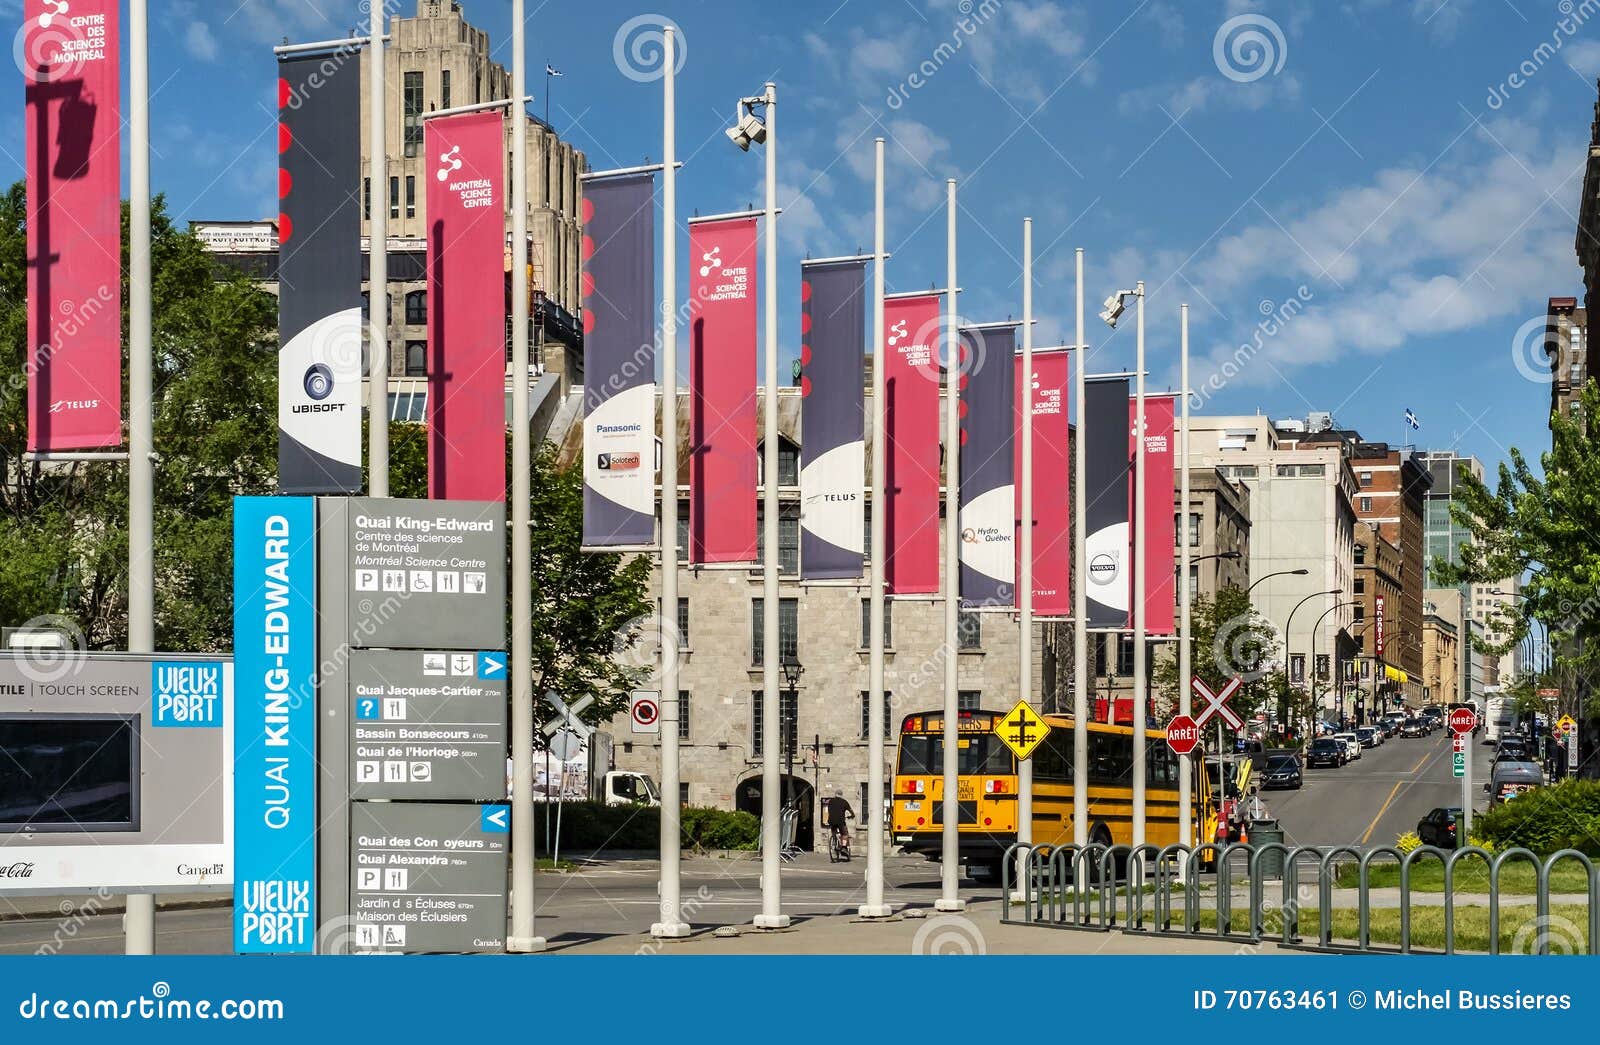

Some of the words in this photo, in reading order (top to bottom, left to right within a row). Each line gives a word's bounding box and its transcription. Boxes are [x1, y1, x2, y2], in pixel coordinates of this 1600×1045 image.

[70, 14, 105, 27] CENTRE
[88, 26, 105, 37] DES
[62, 38, 105, 51] SCIENCES
[460, 188, 492, 200] SCIENCE
[464, 198, 492, 208] CENTRE
[721, 267, 747, 276] CENTRE
[716, 283, 748, 292] SCIENCES
[67, 400, 98, 409] TELUS
[292, 403, 346, 414] UBISOFT
[596, 424, 641, 432] Panasonic
[612, 456, 639, 464] Solotech
[824, 494, 856, 502] TELUS
[356, 516, 391, 529] Quai
[396, 516, 494, 532] King-Edward
[355, 530, 392, 542] Centre
[394, 531, 414, 542] des
[416, 534, 463, 543] sciences
[978, 528, 998, 538] Hydro
[356, 542, 370, 552] de
[372, 543, 419, 552] Montréal
[355, 556, 402, 566] Montréal
[405, 556, 448, 568] Science
[450, 558, 486, 568] Centre
[362, 574, 373, 588] P
[264, 516, 290, 746] KING-EDWARD
[158, 667, 218, 694] VIEUX
[40, 684, 84, 696] TOUCH
[90, 686, 139, 696] SCREEN
[356, 685, 384, 696] Quai
[387, 686, 482, 697] Jacques-Cartier
[356, 728, 396, 738] Bassin
[400, 729, 470, 739] Bonsecours
[1168, 726, 1196, 740] ARRÊT
[356, 747, 384, 758] Quai
[388, 748, 402, 756] de
[406, 747, 458, 758] l'Horloge
[363, 764, 374, 779] P
[264, 757, 290, 829] QUAI
[358, 836, 386, 847] Quai
[389, 837, 410, 847] des
[358, 854, 386, 865] Quai
[388, 854, 448, 865] Alexandra
[177, 864, 224, 876] Canada
[364, 872, 376, 886] P
[243, 880, 308, 912] VIEUX
[357, 898, 390, 909] Jardin
[416, 897, 456, 909] Écluses
[356, 912, 395, 922] Maison
[398, 912, 417, 922] des
[420, 910, 468, 922] Éclusiers
[474, 938, 502, 947] Canada
